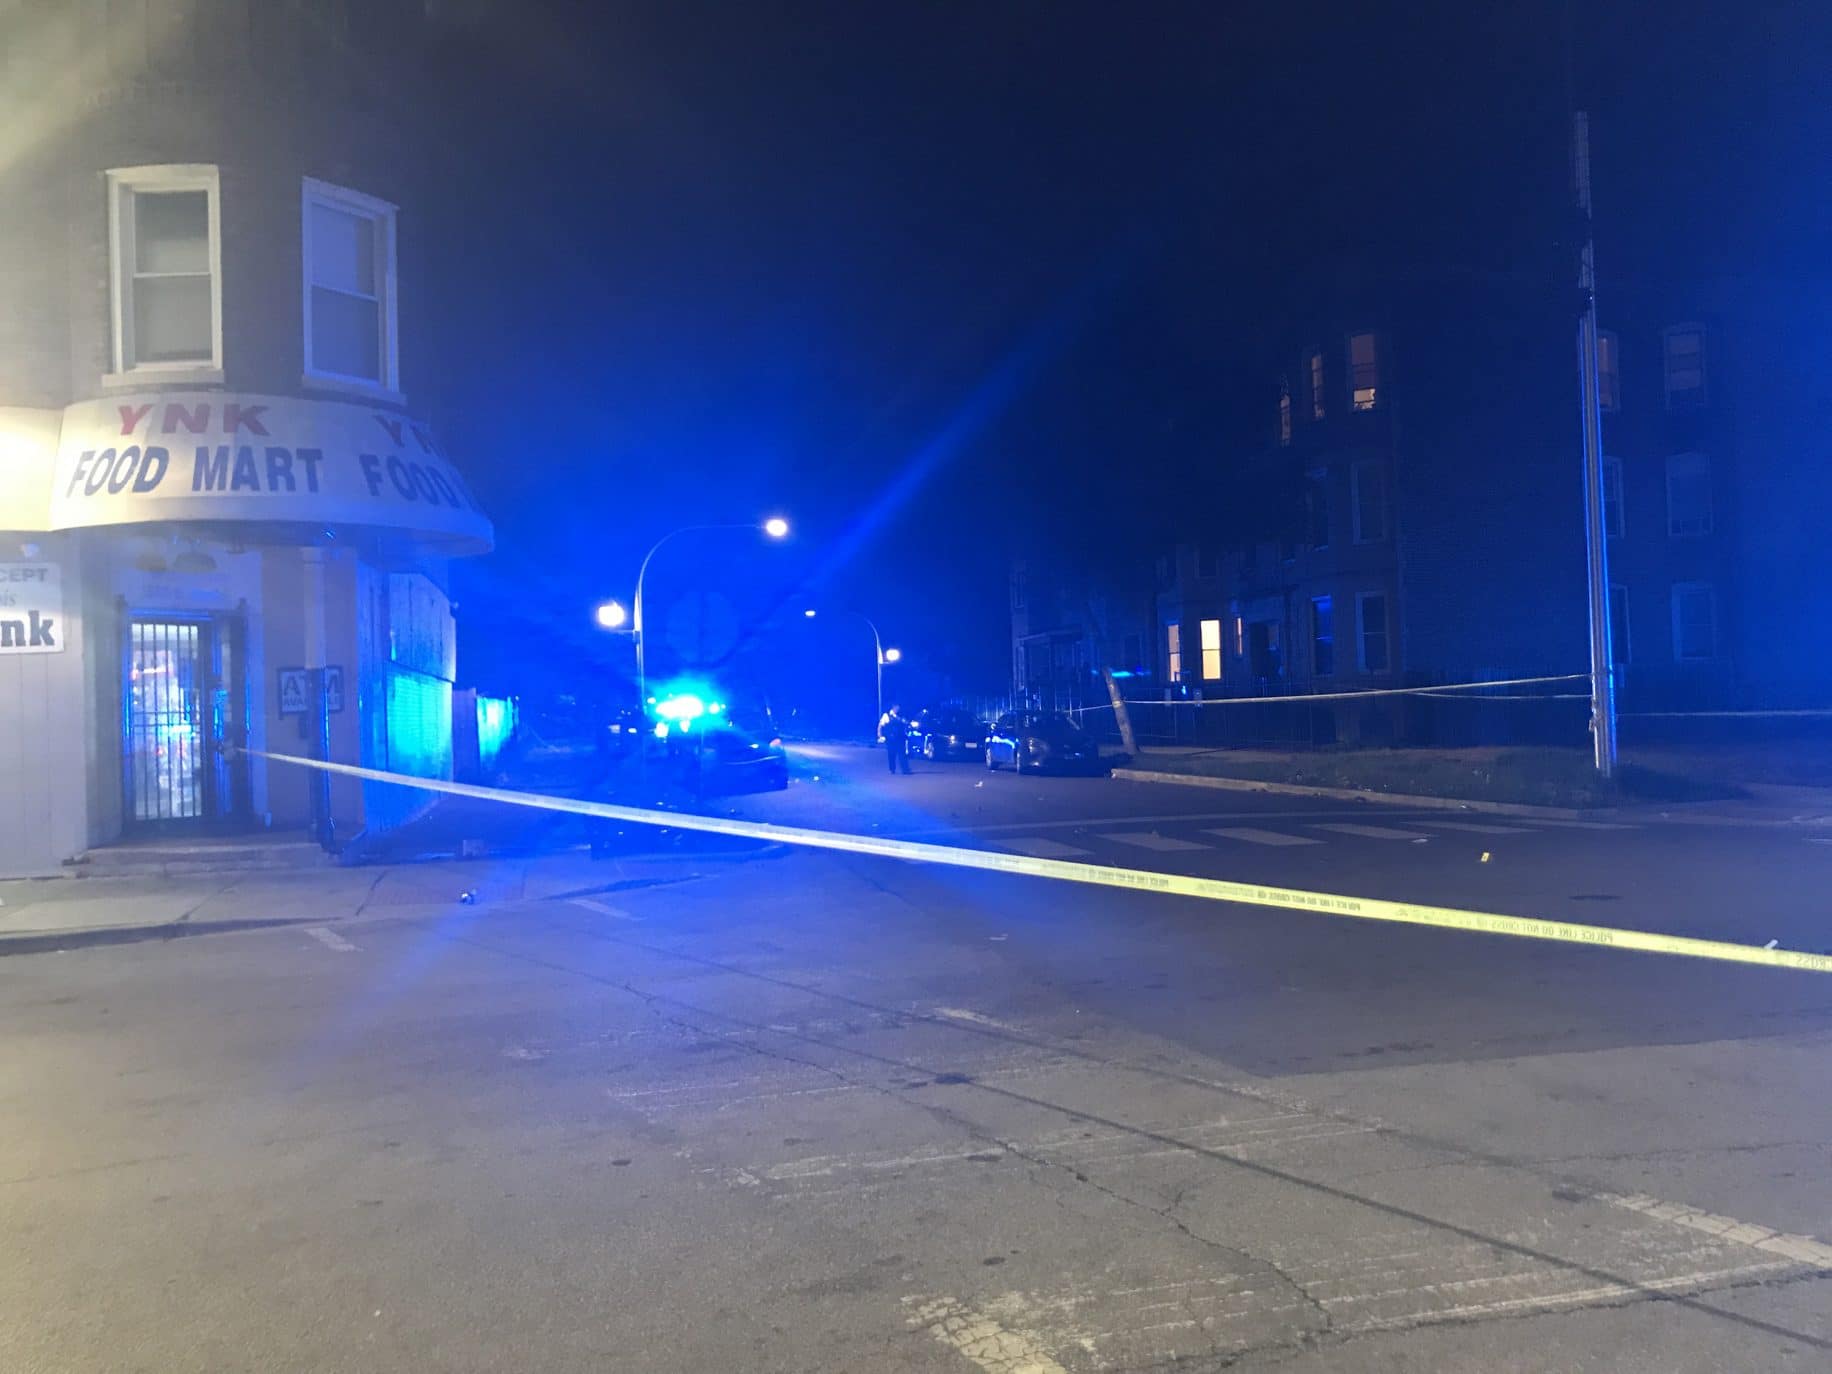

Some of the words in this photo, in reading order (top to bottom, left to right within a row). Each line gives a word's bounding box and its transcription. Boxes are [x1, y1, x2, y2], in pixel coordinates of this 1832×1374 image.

[117, 404, 270, 437] YNK
[66, 445, 170, 499] FOOD
[191, 445, 323, 493] MART
